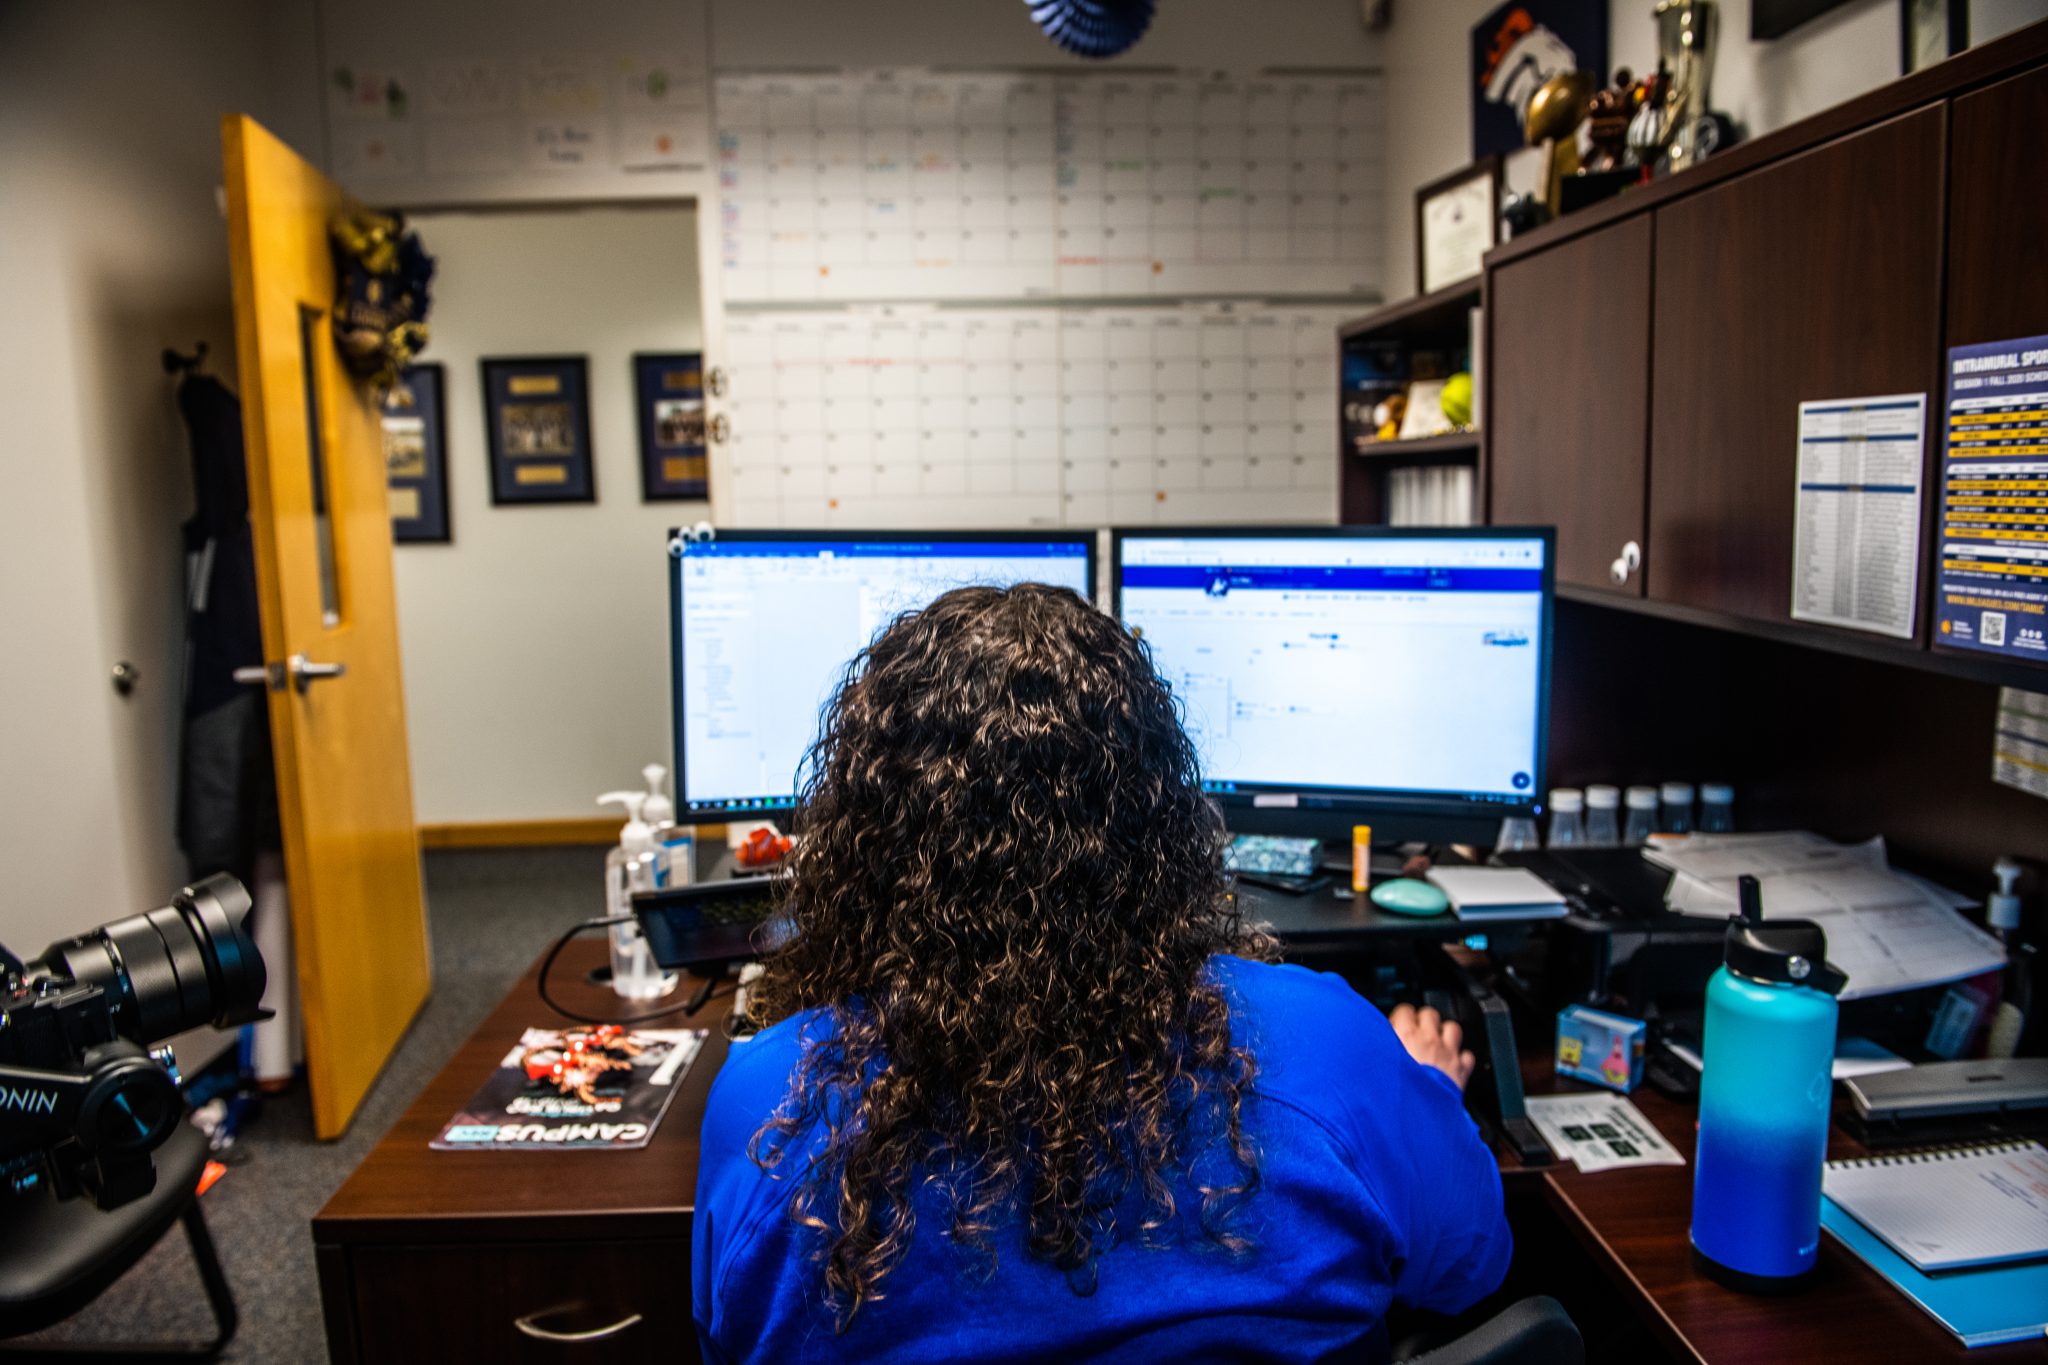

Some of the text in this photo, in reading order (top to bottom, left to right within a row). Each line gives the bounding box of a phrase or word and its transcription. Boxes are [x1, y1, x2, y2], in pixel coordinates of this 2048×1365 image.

[1952, 353, 2019, 375] INTRAMURAL
[1990, 375, 2005, 386] FALL
[496, 1123, 648, 1141] CAMPUS
